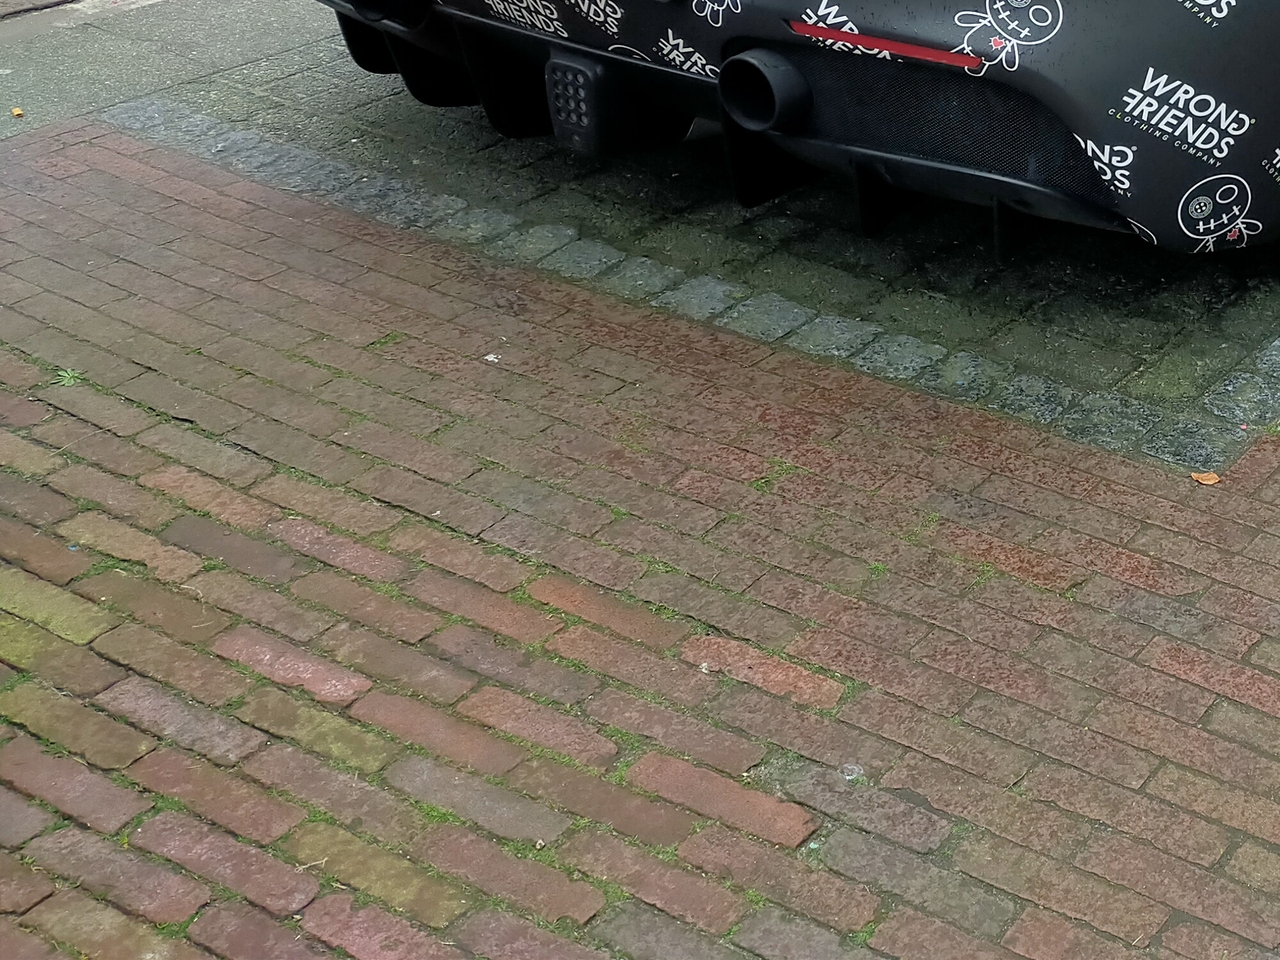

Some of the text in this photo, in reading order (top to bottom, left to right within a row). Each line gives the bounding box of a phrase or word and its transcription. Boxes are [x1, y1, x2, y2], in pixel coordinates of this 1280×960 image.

[1121, 87, 1235, 159] FRIENDS
[1142, 66, 1251, 136] WRONG
[1107, 107, 1222, 169] CLOTHING COMPANY
